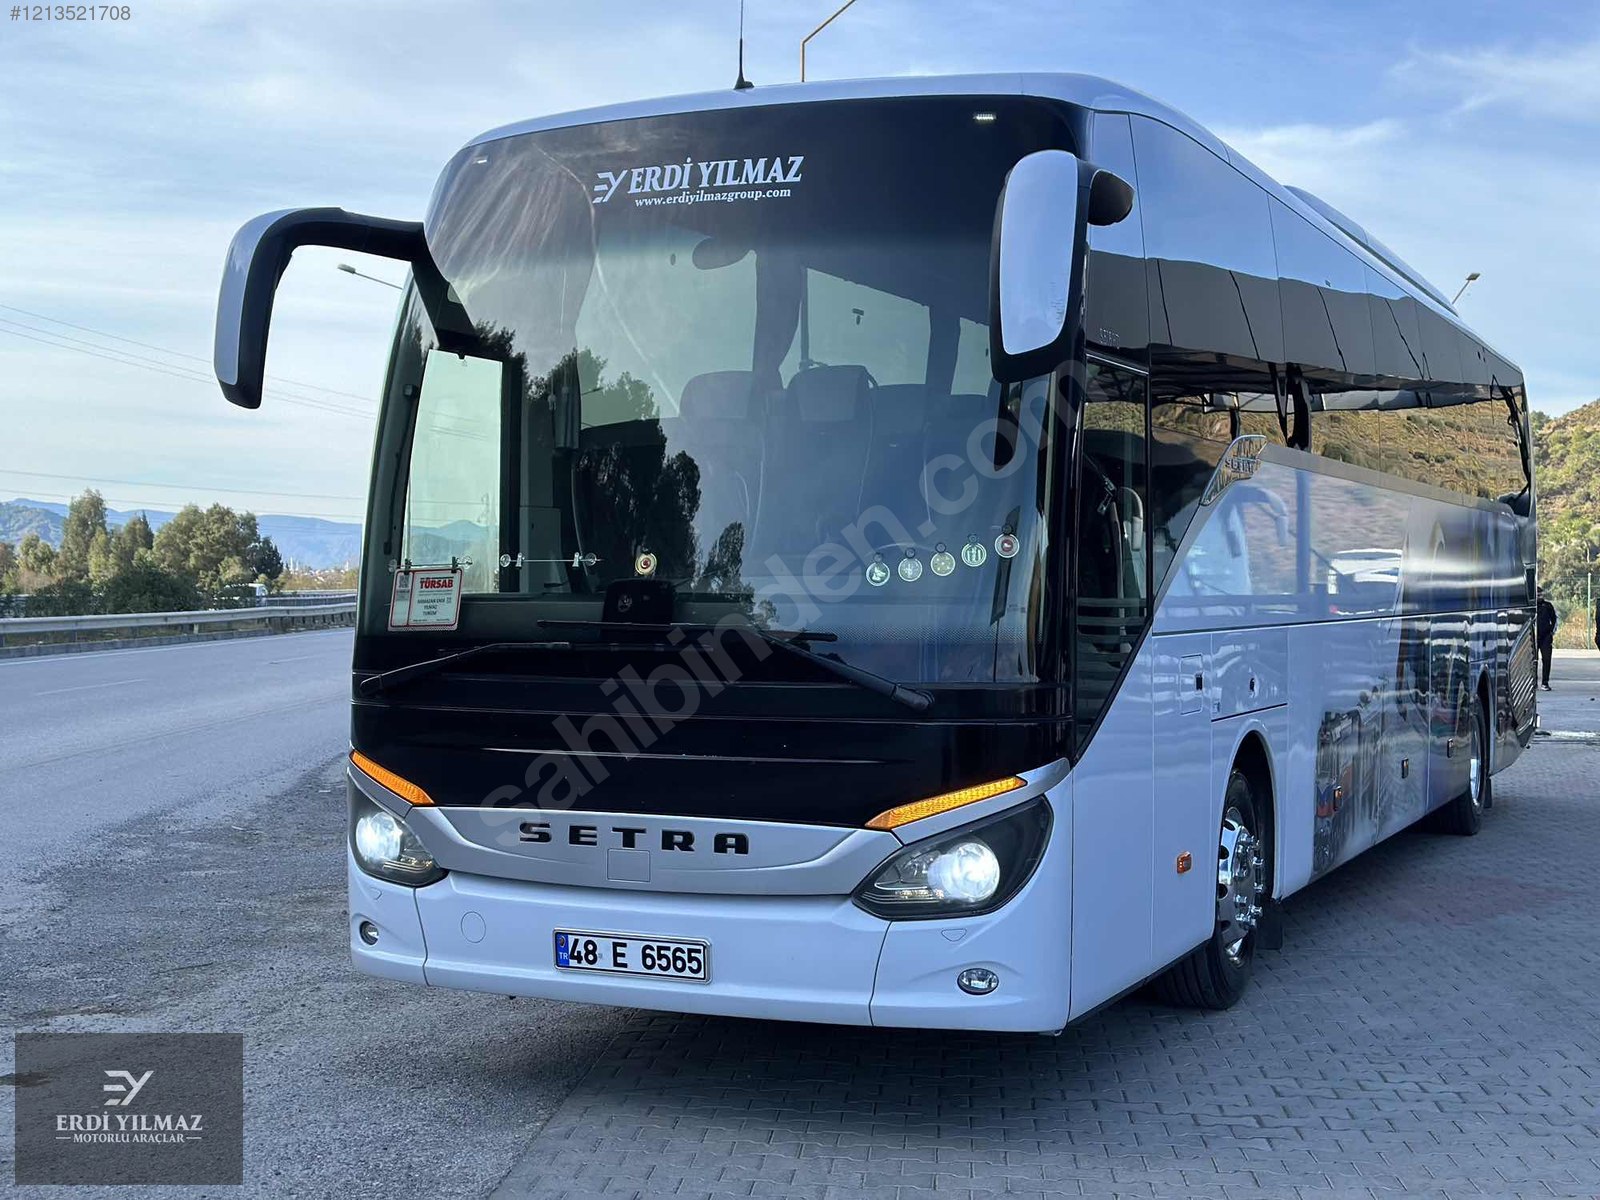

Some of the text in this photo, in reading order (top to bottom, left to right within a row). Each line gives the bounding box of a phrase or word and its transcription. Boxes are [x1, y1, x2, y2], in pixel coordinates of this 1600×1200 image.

[627, 157, 693, 194] ERDİ
[698, 156, 805, 188] YILMAZ
[635, 188, 791, 207] www.erdiyilmazgroup.com
[519, 822, 749, 855] SETRA
[569, 938, 598, 965] 48
[612, 941, 628, 968] E
[641, 944, 702, 975] 6565
